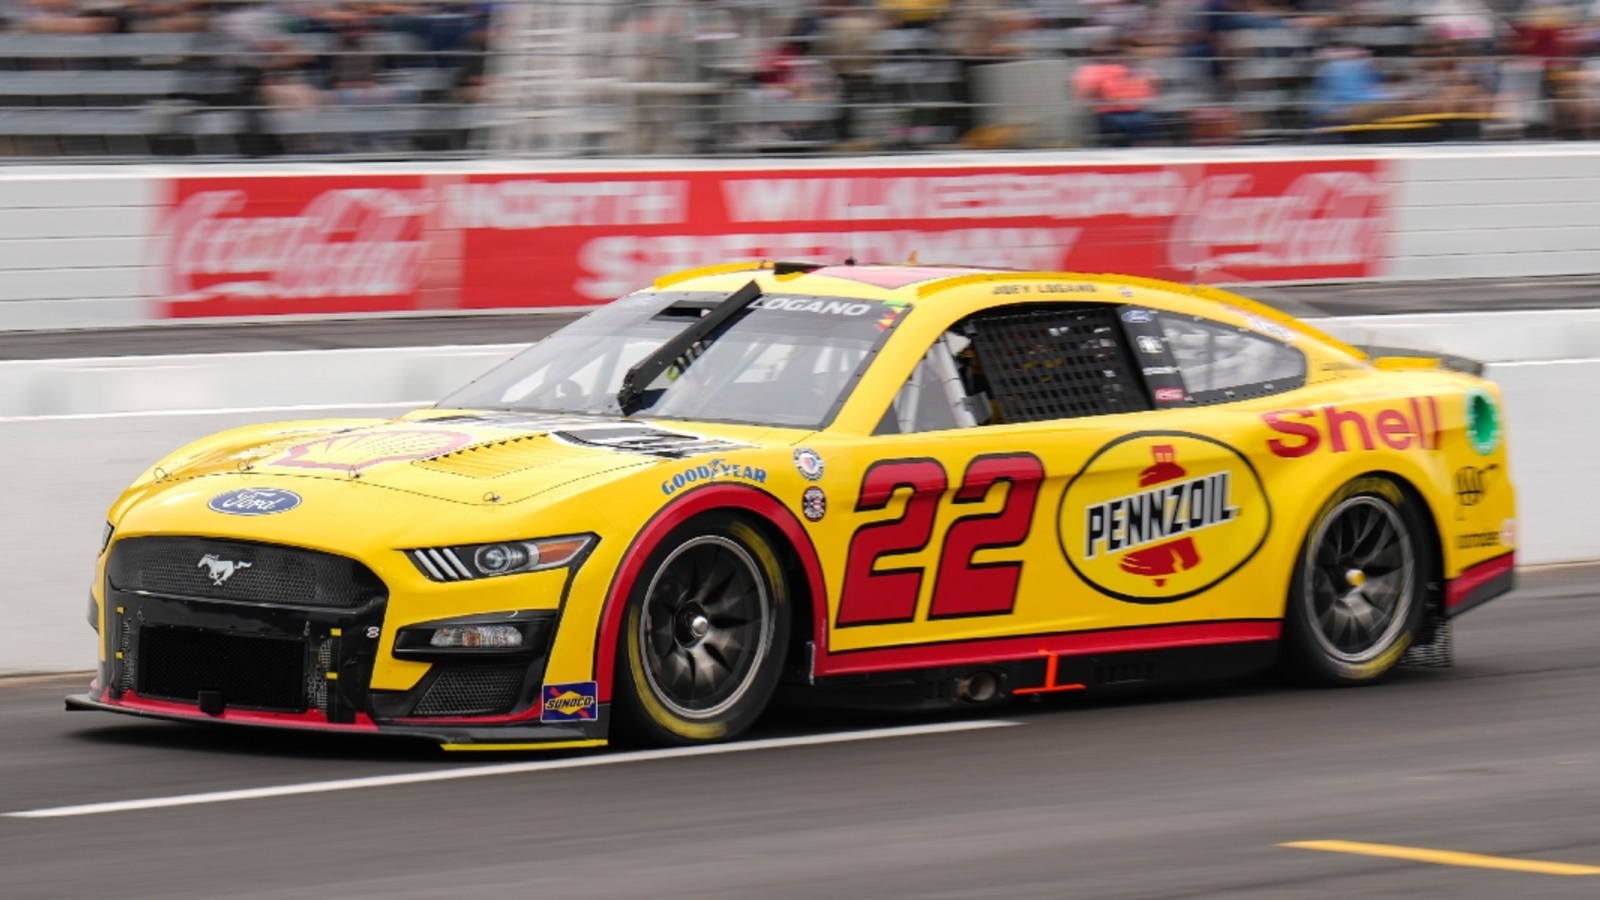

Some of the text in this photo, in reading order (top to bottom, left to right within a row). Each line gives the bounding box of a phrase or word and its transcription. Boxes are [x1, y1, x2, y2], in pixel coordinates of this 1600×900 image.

[443, 179, 689, 229] NORTH
[747, 297, 872, 316] LOGANO
[1263, 396, 1443, 459] Shell
[661, 462, 767, 496] GOODYEAR
[222, 491, 286, 511] Ford
[1085, 470, 1232, 560] PENNZOIL
[834, 452, 1046, 629] 22
[546, 696, 593, 710] SUNOCO
